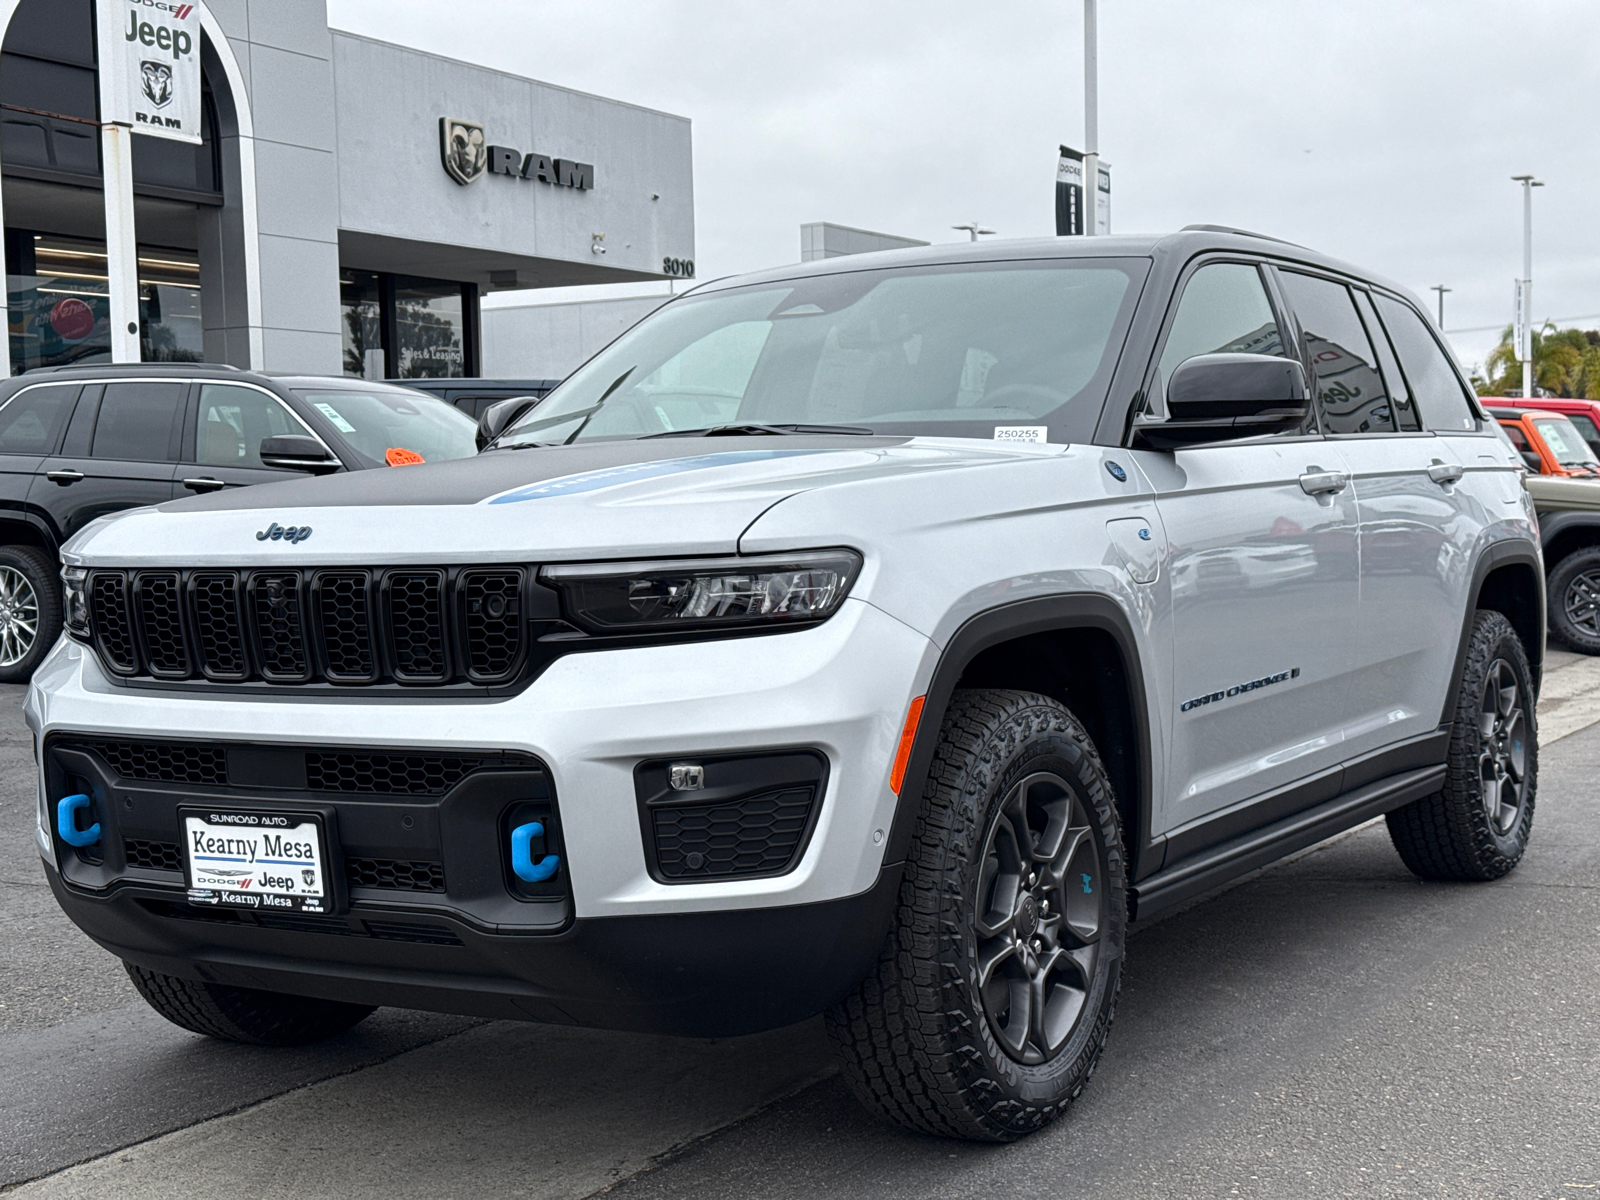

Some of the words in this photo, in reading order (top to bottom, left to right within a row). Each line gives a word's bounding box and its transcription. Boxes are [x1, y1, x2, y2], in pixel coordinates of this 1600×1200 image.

[125, 9, 192, 60] Jeep
[135, 111, 182, 129] RAM
[486, 145, 594, 191] RAM
[663, 256, 695, 277] 8010
[401, 346, 423, 360] Sales
[423, 347, 430, 359] &
[430, 346, 461, 363] Leasing
[997, 430, 1039, 438] 250255
[255, 522, 313, 545] Jeep
[1181, 689, 1225, 712] GRAND
[1226, 670, 1290, 698] CHEROKEE
[210, 814, 259, 824] SUNROAD
[261, 816, 288, 826] AUTO
[192, 830, 258, 863] Kearny
[263, 834, 315, 859] Mesa
[258, 871, 294, 892] Jeep
[221, 891, 261, 908] Kearny
[262, 894, 293, 907] Mesa
[304, 897, 320, 906] Jeep
